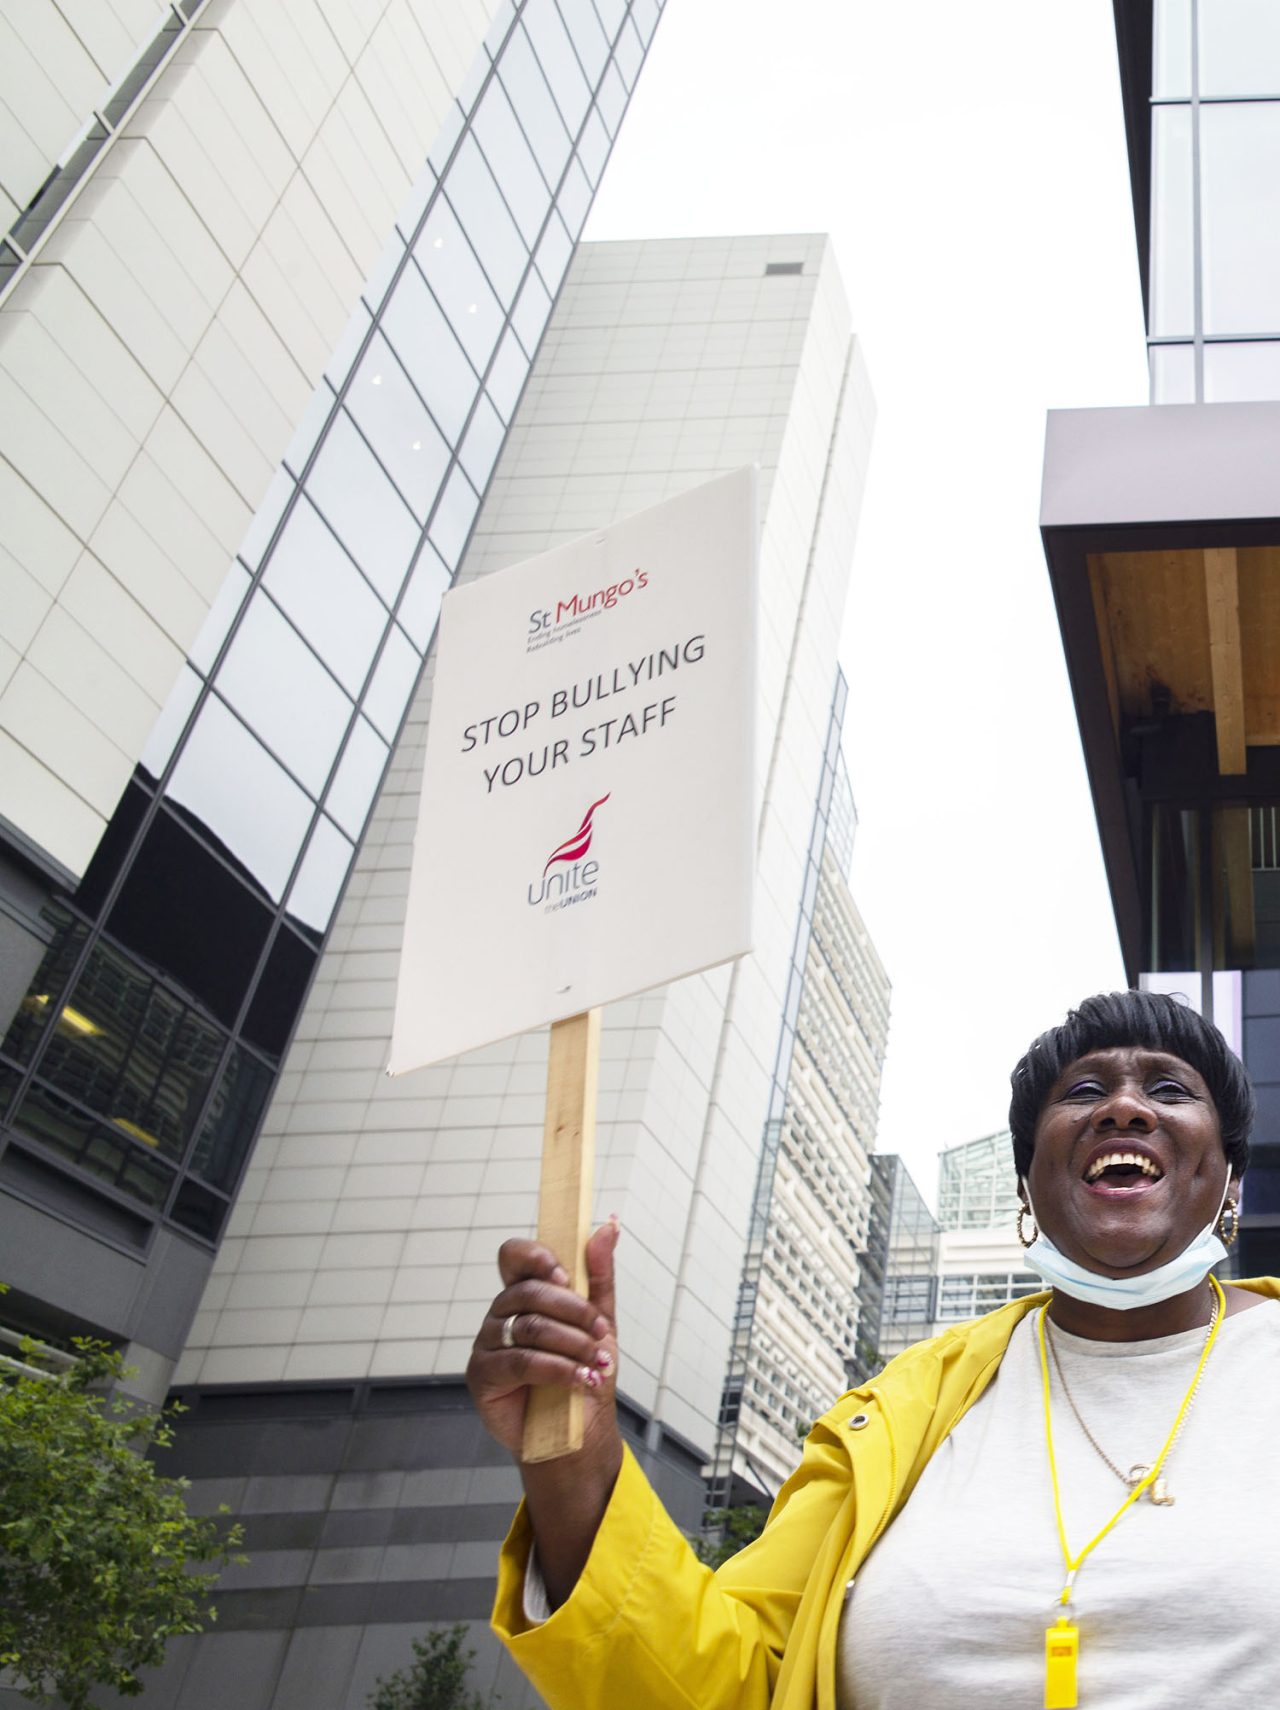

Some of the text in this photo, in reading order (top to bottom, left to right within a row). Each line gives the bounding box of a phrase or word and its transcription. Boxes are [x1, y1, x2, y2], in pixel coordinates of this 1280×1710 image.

[528, 568, 649, 634] St Mungo's
[461, 634, 706, 752] STOP BULLYING
[483, 695, 677, 794] YOUR STAFF
[528, 860, 600, 905] unite
